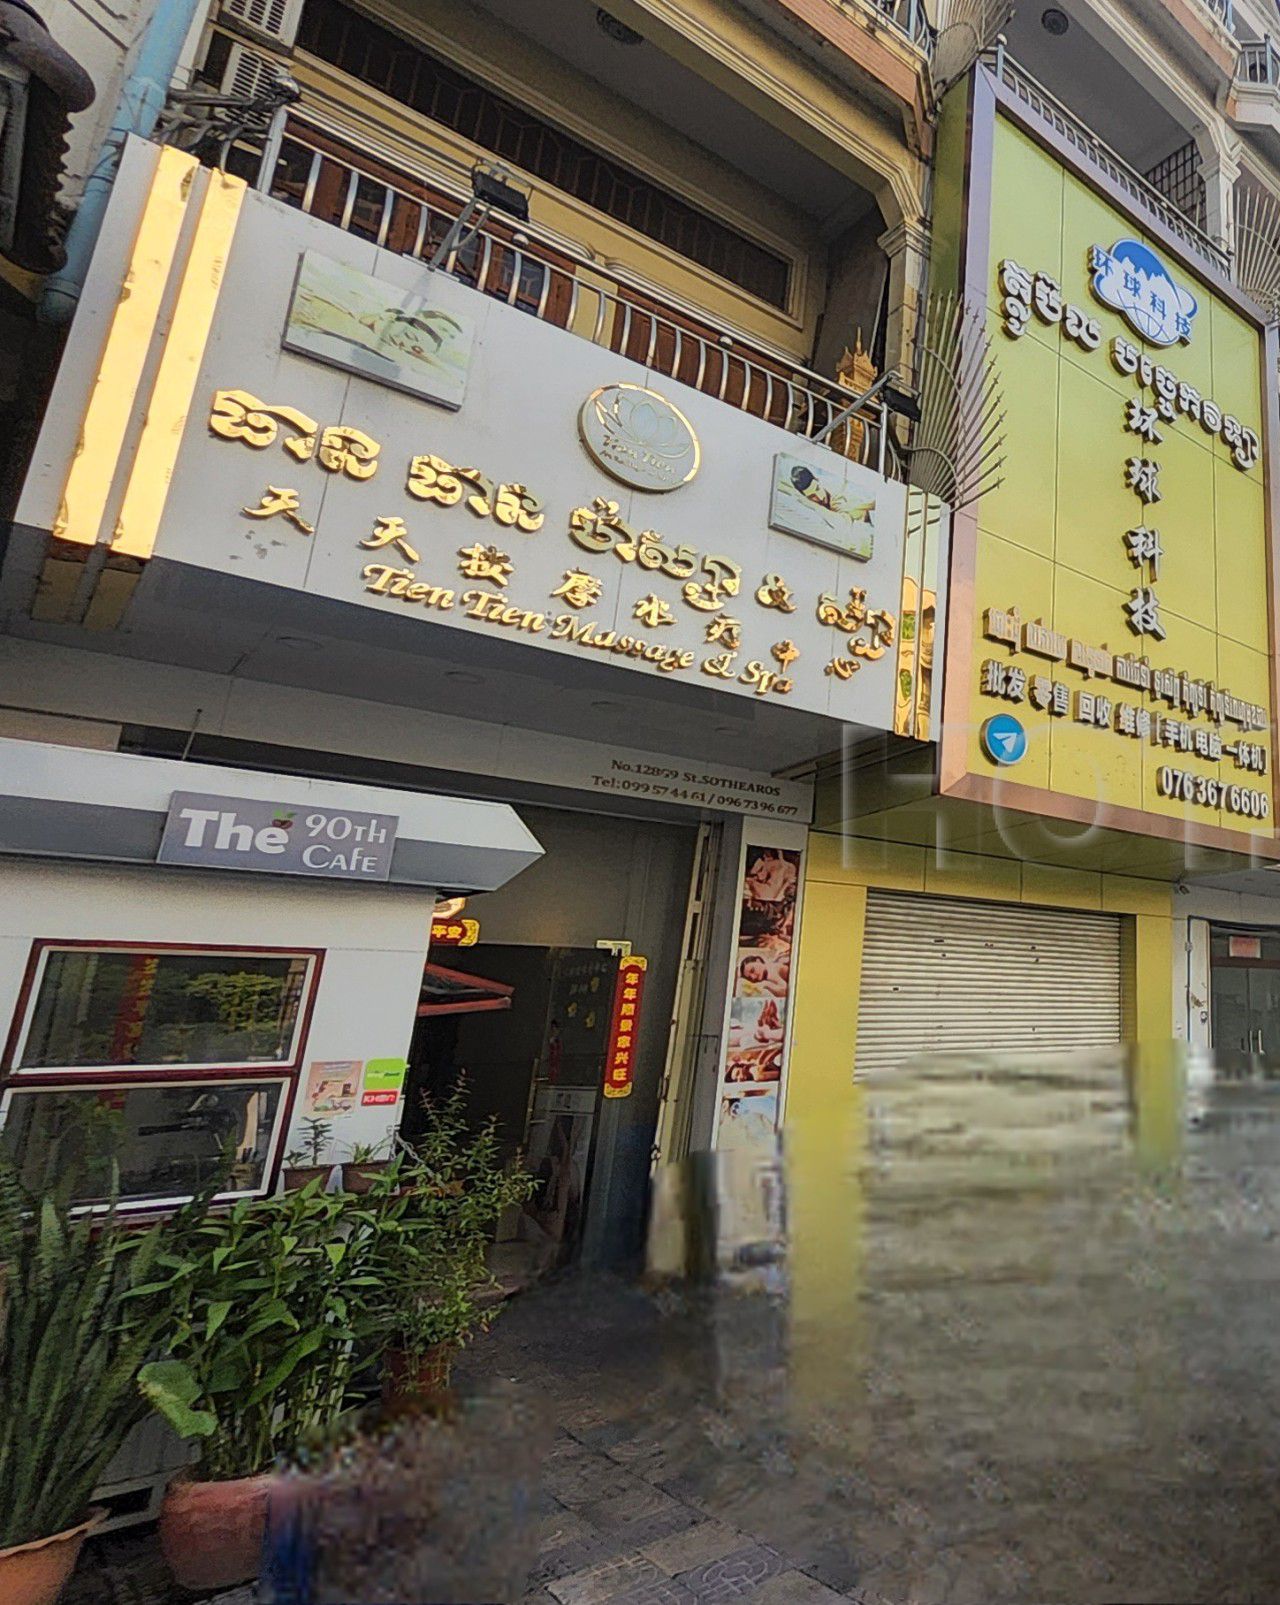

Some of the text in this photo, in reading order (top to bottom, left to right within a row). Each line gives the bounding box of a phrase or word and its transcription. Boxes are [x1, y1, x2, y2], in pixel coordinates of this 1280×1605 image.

[363, 563, 456, 610] Tien
[462, 589, 547, 635] Tien
[550, 613, 697, 673] Massage
[740, 660, 795, 696] Spa
[984, 659, 1026, 701] 批发
[1034, 674, 1070, 715] 零售
[1078, 691, 1112, 727] 回收
[1119, 702, 1151, 738] 维修
[180, 807, 290, 854] The
